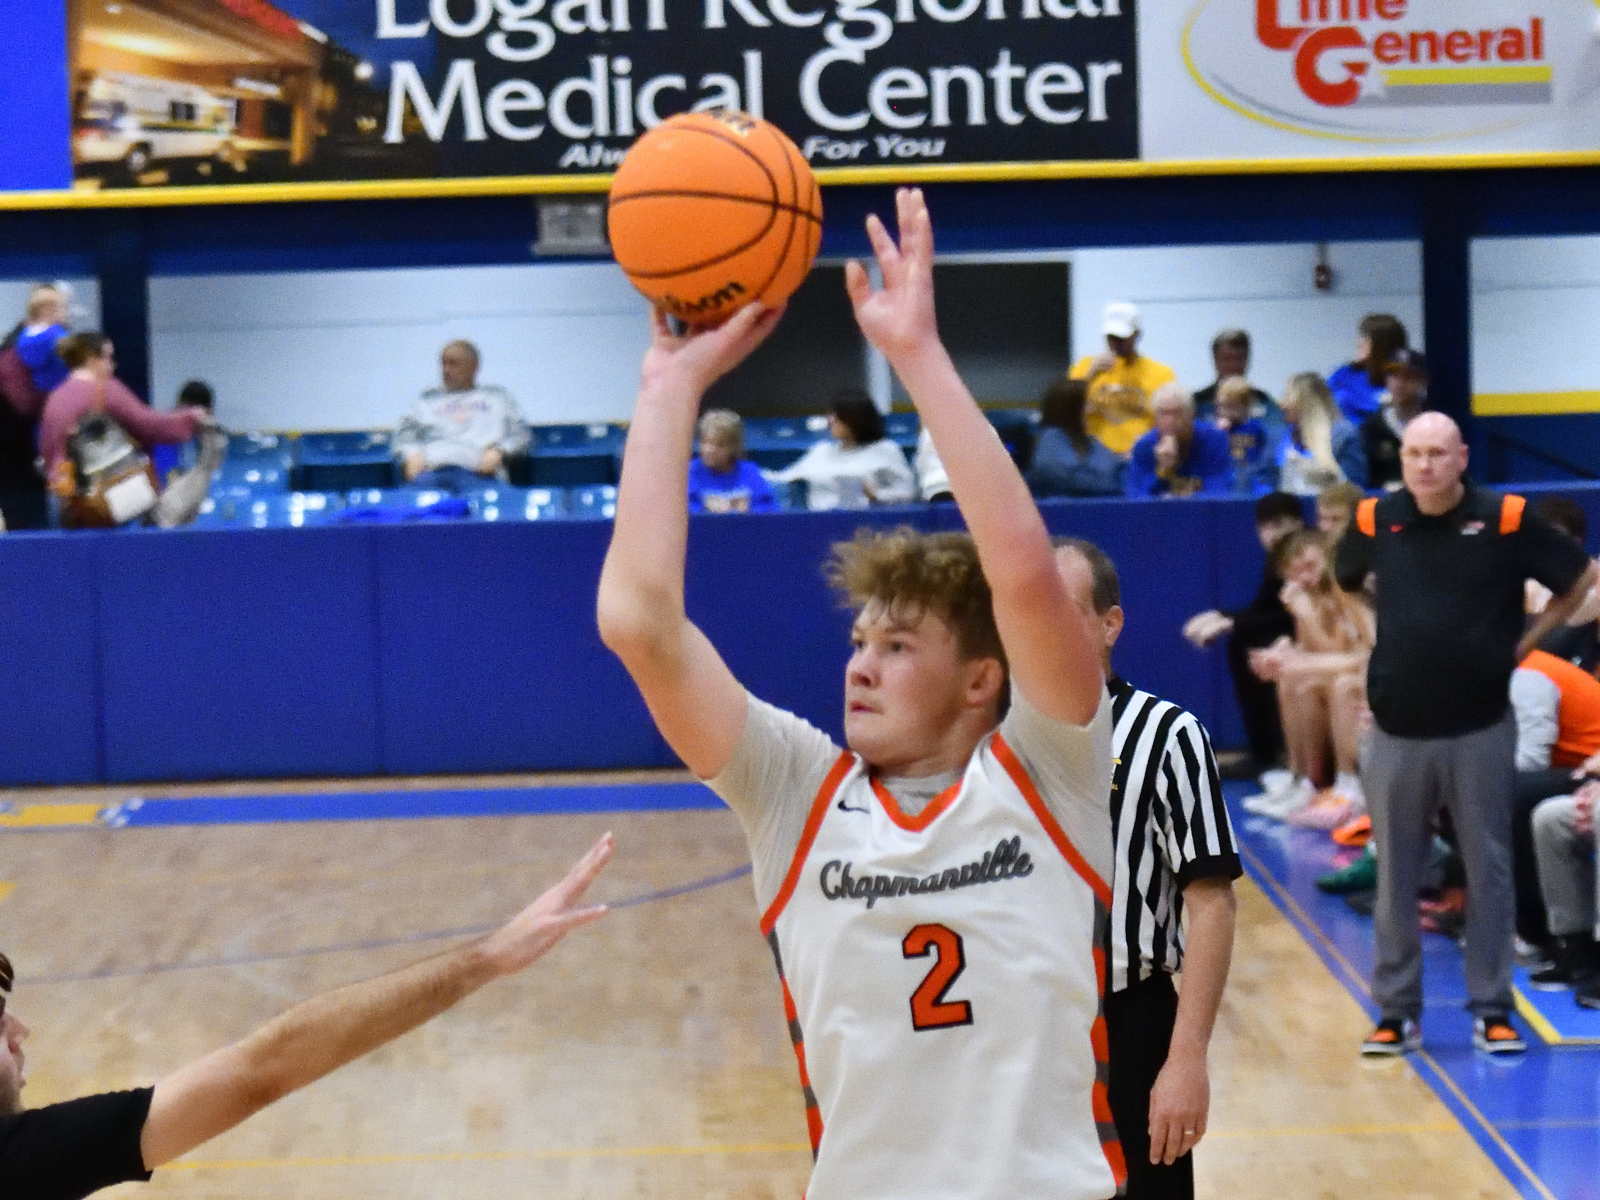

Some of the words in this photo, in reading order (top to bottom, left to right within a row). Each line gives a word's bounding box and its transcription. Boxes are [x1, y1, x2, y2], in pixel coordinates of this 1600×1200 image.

[383, 49, 765, 143] Medical
[800, 47, 1123, 132] Center
[1294, 17, 1545, 107] General
[803, 135, 868, 160] For
[875, 132, 946, 158] You
[820, 835, 1035, 910] Chapmanville
[901, 922, 974, 1032] 2
